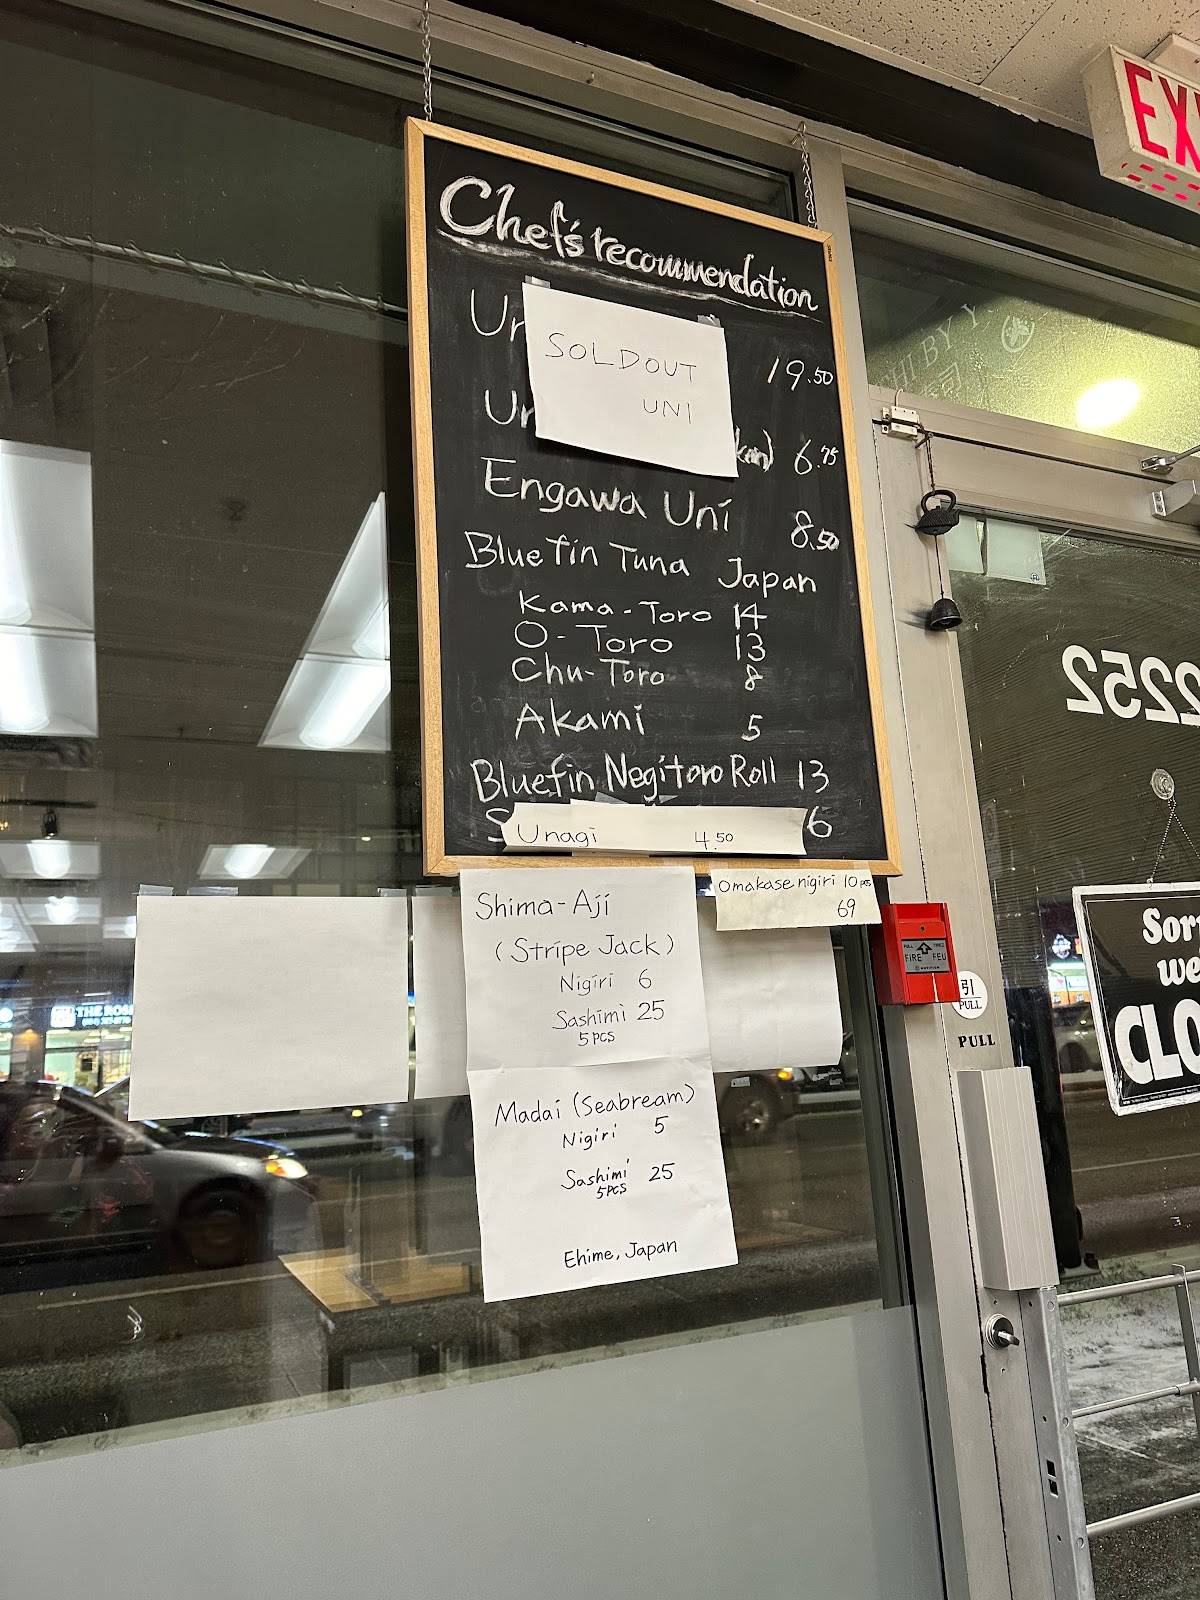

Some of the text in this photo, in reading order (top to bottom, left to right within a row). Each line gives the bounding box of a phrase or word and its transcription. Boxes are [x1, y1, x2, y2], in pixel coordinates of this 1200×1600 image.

[1124, 60, 1200, 173] EX
[440, 176, 818, 311] Chef's recommendation
[766, 356, 834, 391] 19.50
[643, 399, 692, 424] UNI
[795, 439, 839, 475] 6.75
[481, 457, 840, 551] Engawa Uni 8.50
[609, 541, 690, 577] Tuna
[717, 557, 817, 598] Japan
[733, 602, 767, 630] 14
[736, 632, 766, 662] 13
[744, 664, 763, 691] 8
[515, 698, 763, 741] Akami 5
[470, 752, 830, 803] Bluefin Negitoro Roll 13
[806, 806, 832, 837] 6
[518, 824, 733, 850] Unagi 4.50
[718, 876, 794, 893] Omakase
[798, 875, 835, 894] nigiri
[837, 899, 856, 917] 69
[1143, 908, 1200, 945] Sor
[904, 952, 947, 962] FIRE FEU
[560, 968, 652, 996] Nigiri 6
[960, 979, 975, 996] 引
[552, 1000, 665, 1029] Sashimi 25
[960, 1000, 982, 1010] PULL
[958, 1033, 996, 1048] PULL
[495, 1083, 695, 1127] Madai (Seabream)
[562, 1115, 669, 1150] Nigiri 5
[561, 1158, 675, 1190] Sashimi 25
[564, 1240, 678, 1268] Ehime, Japan
